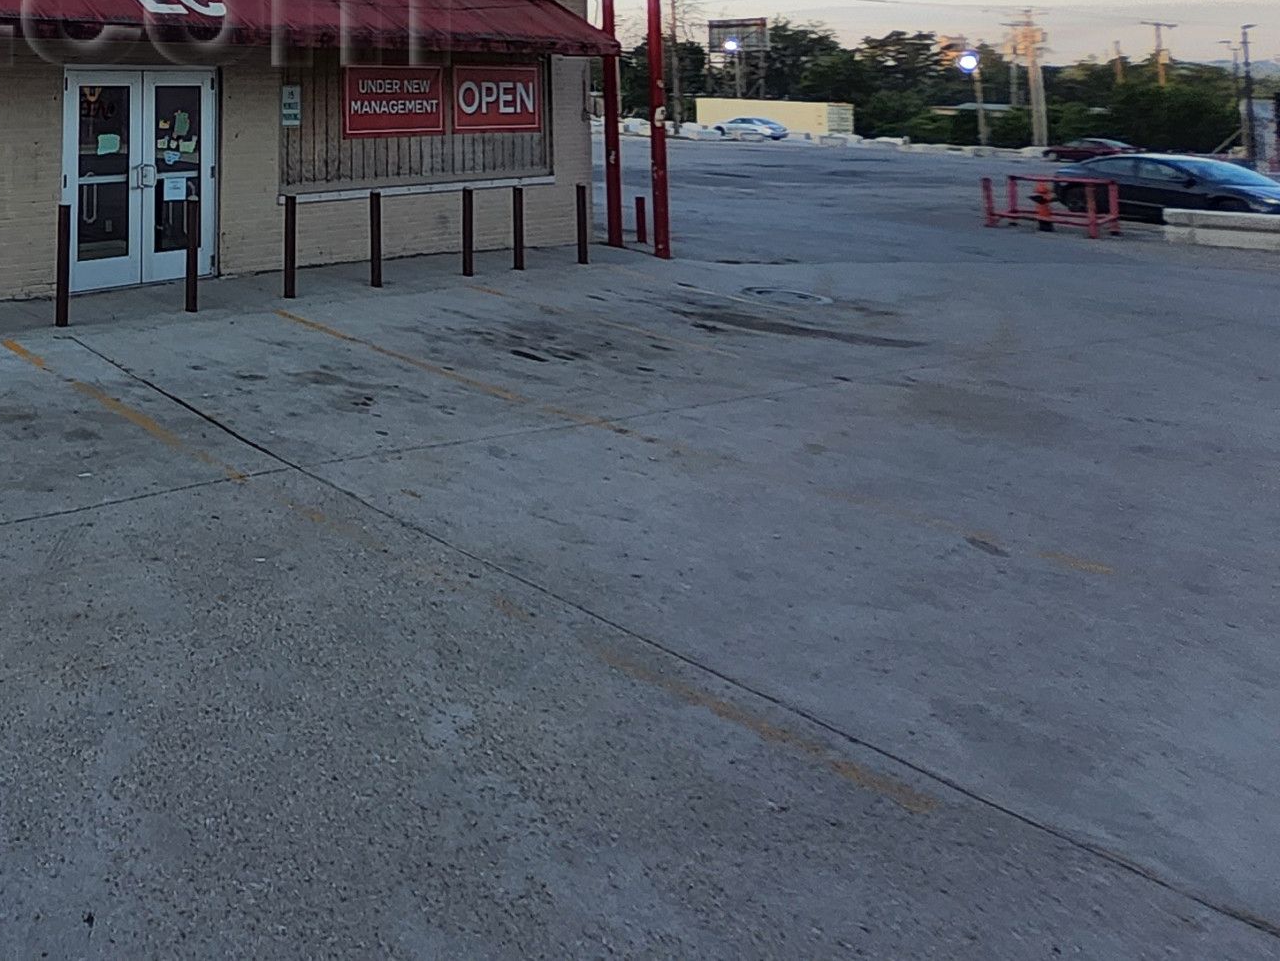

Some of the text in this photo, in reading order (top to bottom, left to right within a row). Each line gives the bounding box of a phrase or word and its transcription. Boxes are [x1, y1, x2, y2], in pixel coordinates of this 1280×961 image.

[358, 79, 431, 94] UNDER NEW
[458, 81, 535, 115] OPEN
[350, 100, 439, 116] MANAGEMENT
